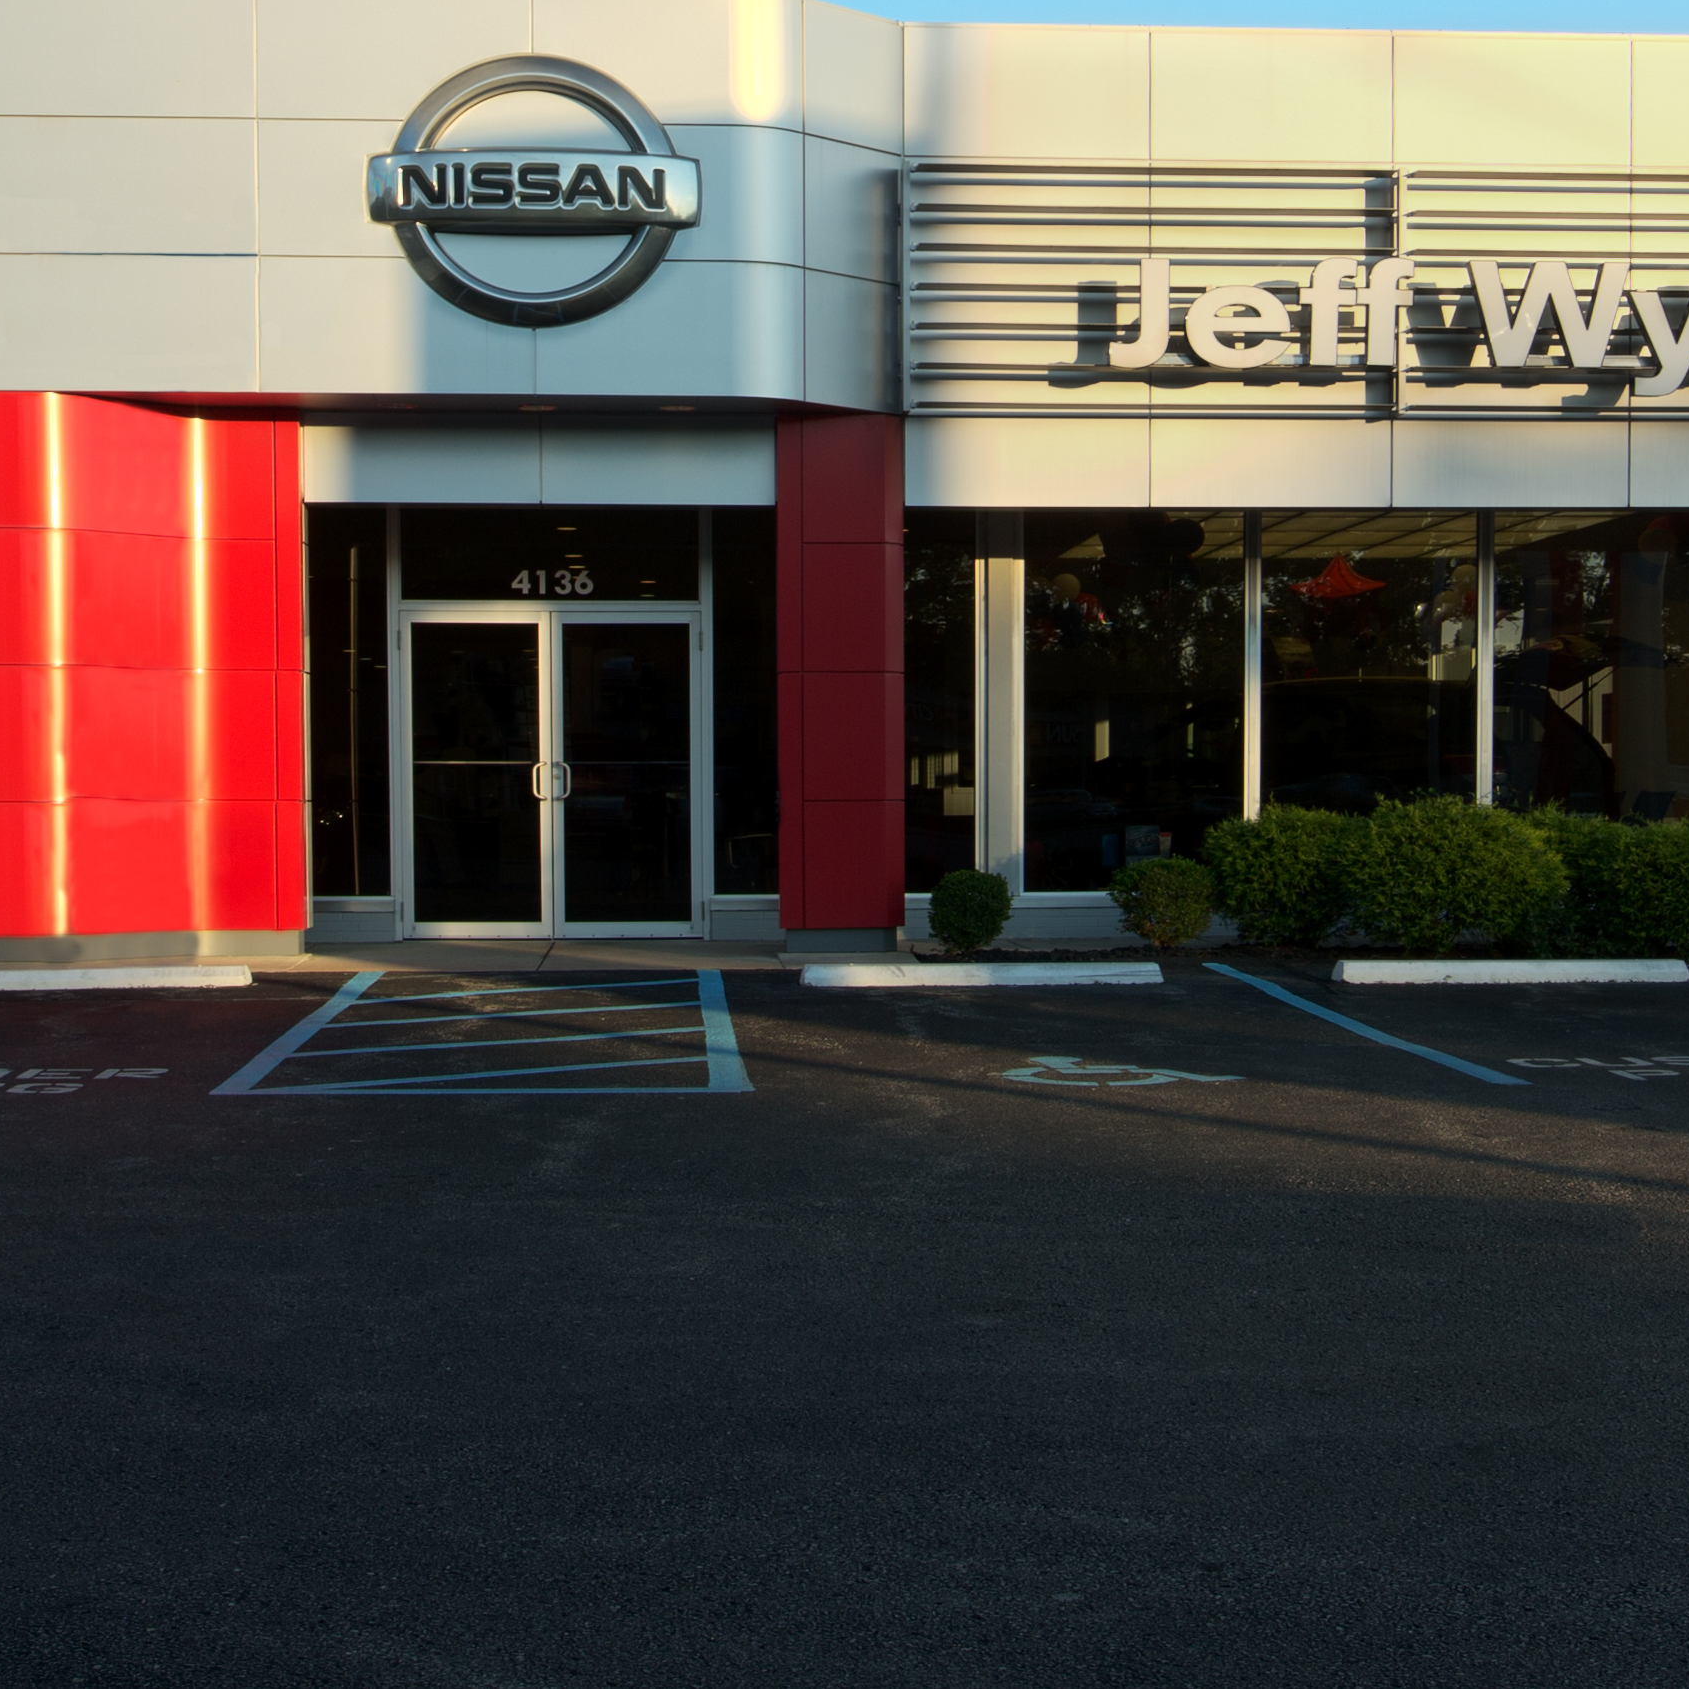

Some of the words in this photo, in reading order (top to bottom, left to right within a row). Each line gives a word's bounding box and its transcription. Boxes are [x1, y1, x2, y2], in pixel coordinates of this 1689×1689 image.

[397, 162, 668, 211] NISSAN
[1109, 257, 1413, 369] Jeff
[511, 569, 594, 595] 4136
